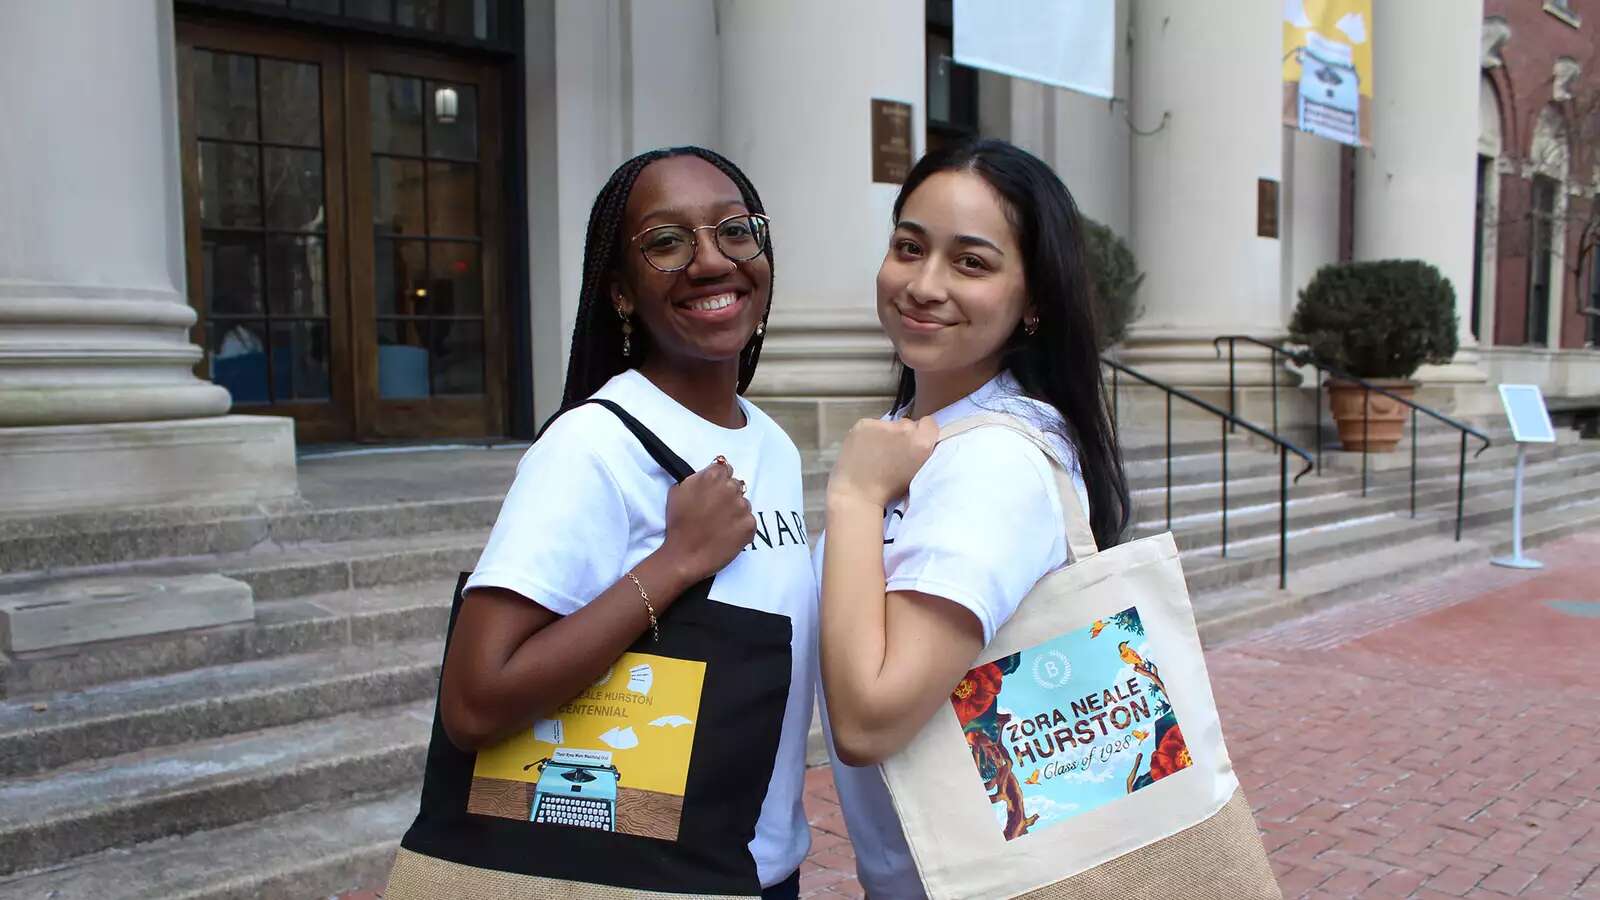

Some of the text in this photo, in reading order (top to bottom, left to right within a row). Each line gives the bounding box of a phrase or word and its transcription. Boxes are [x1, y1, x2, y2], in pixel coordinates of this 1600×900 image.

[743, 510, 808, 551] NAR
[1044, 661, 1058, 678] B
[558, 703, 629, 718] CENTENNIAL
[605, 691, 653, 706] HURSTON
[1006, 677, 1142, 743] ZORA NEALE
[1012, 695, 1151, 768] HURSTON
[1043, 735, 1133, 780] Class of 1928
